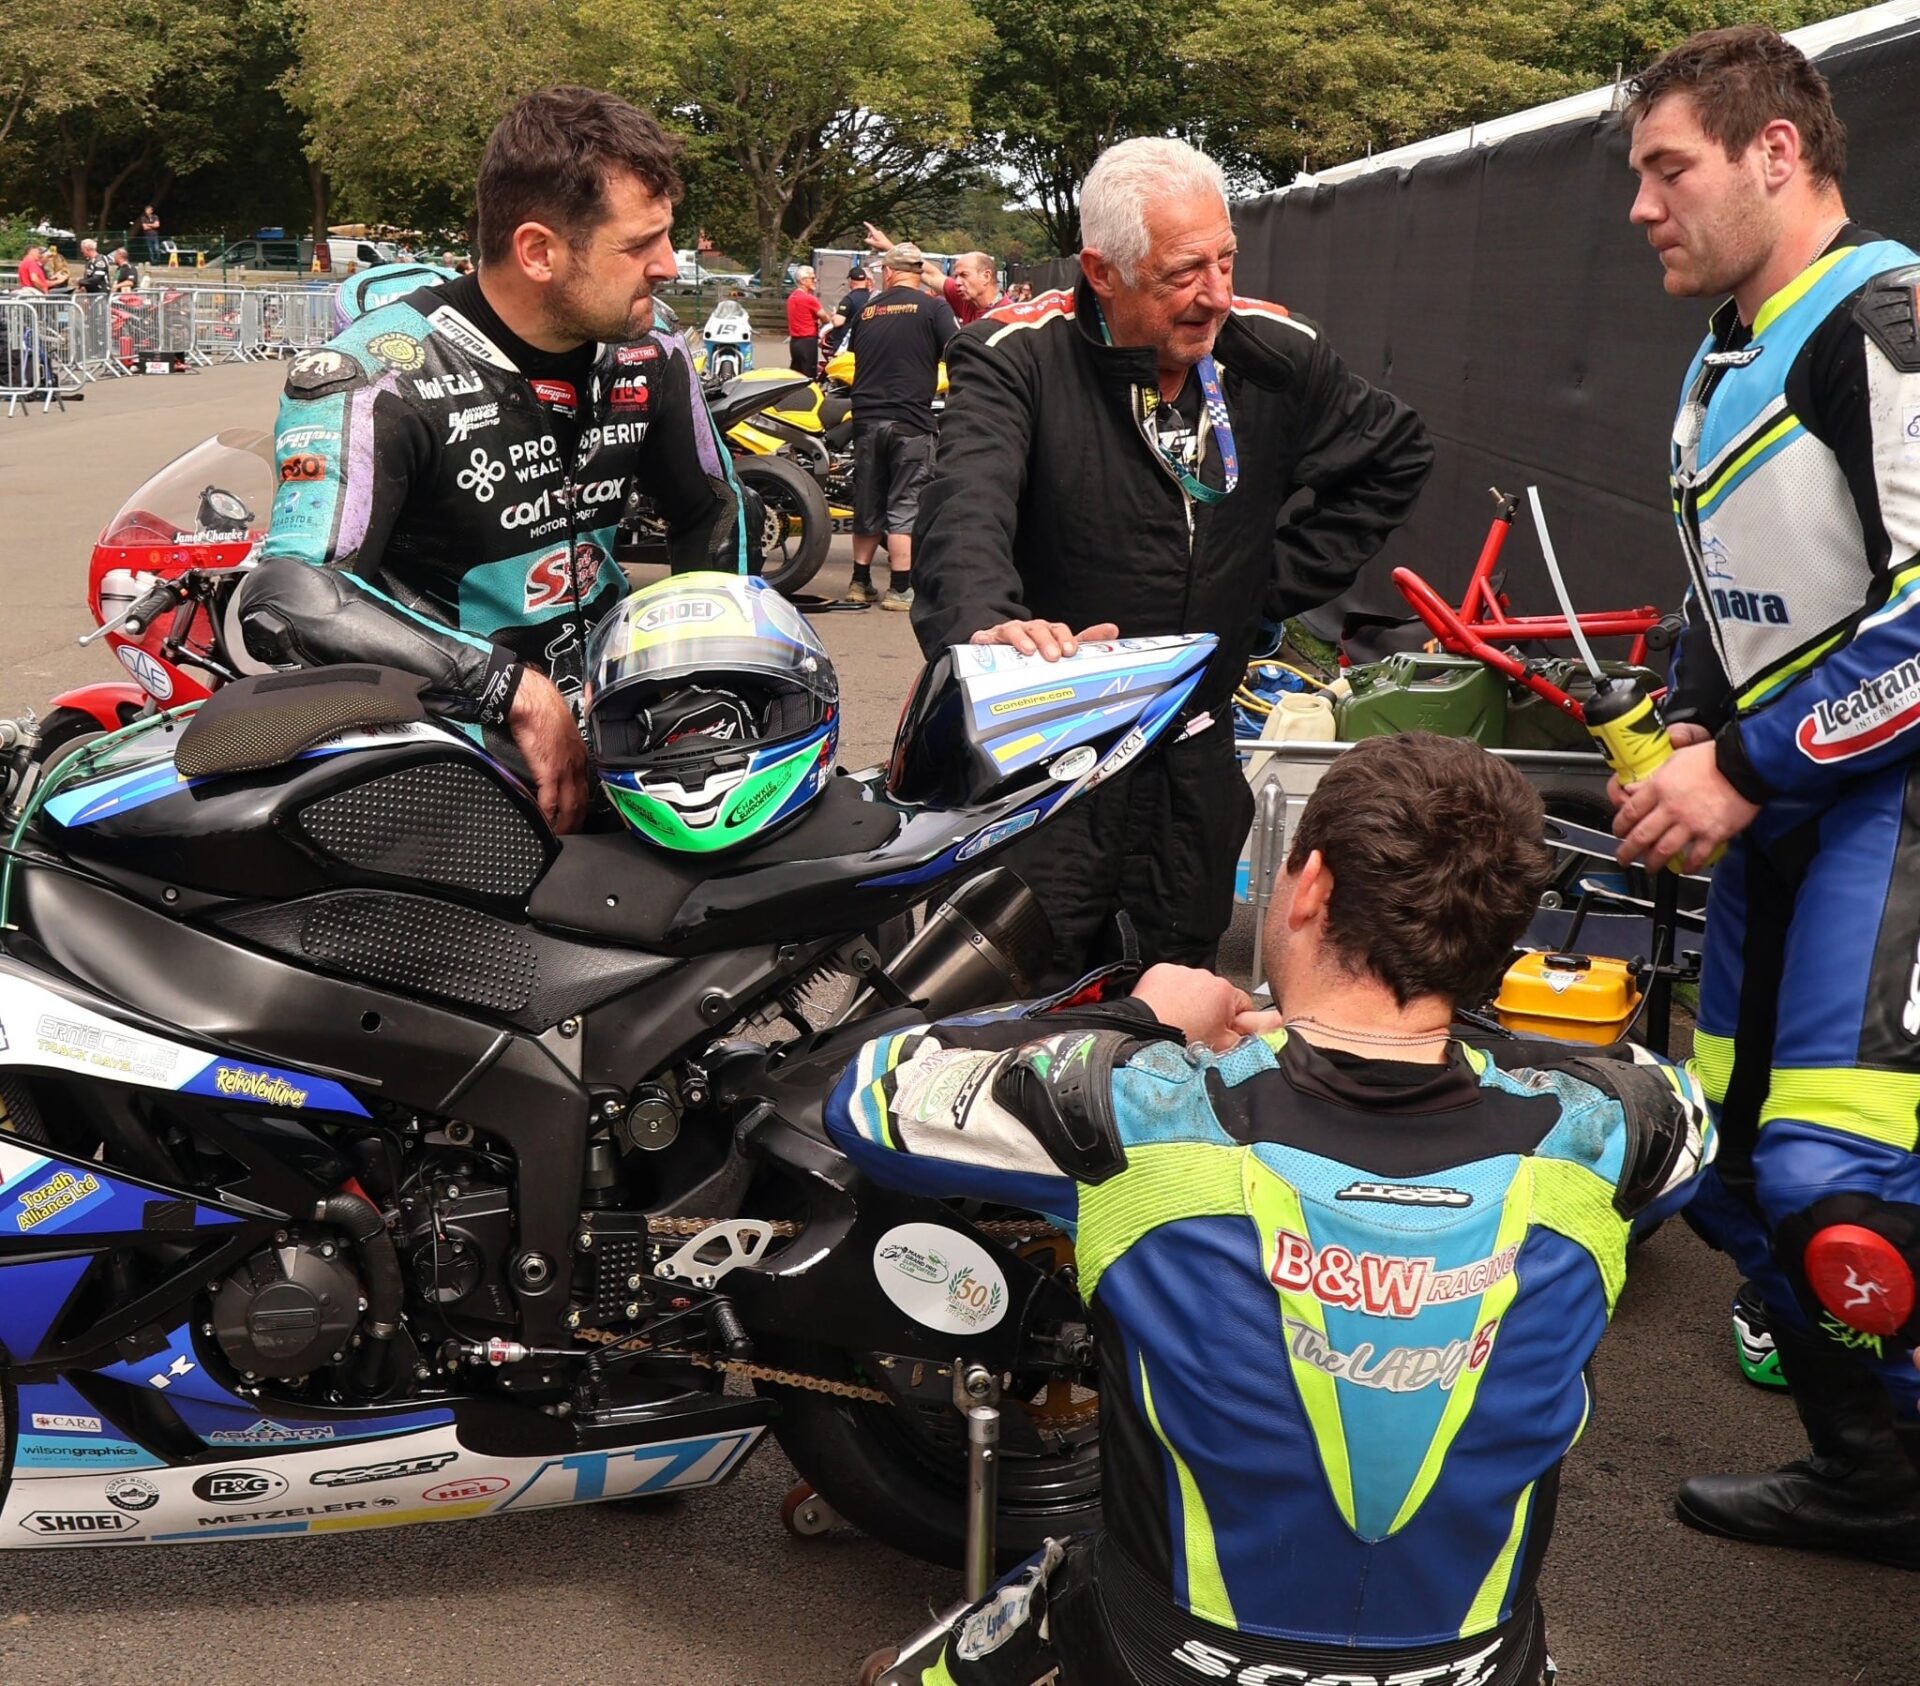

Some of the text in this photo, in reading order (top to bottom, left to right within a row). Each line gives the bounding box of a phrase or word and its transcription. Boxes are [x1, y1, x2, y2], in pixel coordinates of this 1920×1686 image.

[617, 347, 656, 362] QUATTRO
[646, 602, 712, 626] SHOEI
[993, 688, 1075, 713] Conehire.com
[1855, 686, 1920, 731] INTERNATIO
[1101, 733, 1142, 772] CARA
[736, 780, 774, 815] CHAWKIE
[739, 786, 778, 822] SUPPORTERS
[18, 1174, 98, 1231] Alliance Ltd
[20, 1171, 74, 1208] Toradh
[1271, 1231, 1518, 1317] B&W RACING
[53, 1418, 100, 1429] CARA
[311, 1452, 457, 1484] SCOTT
[562, 1437, 720, 1500] 17
[212, 1478, 270, 1495] R&G
[438, 1484, 496, 1499] HEL
[36, 1515, 123, 1531] SHOEI
[197, 1500, 369, 1526] METZELER
